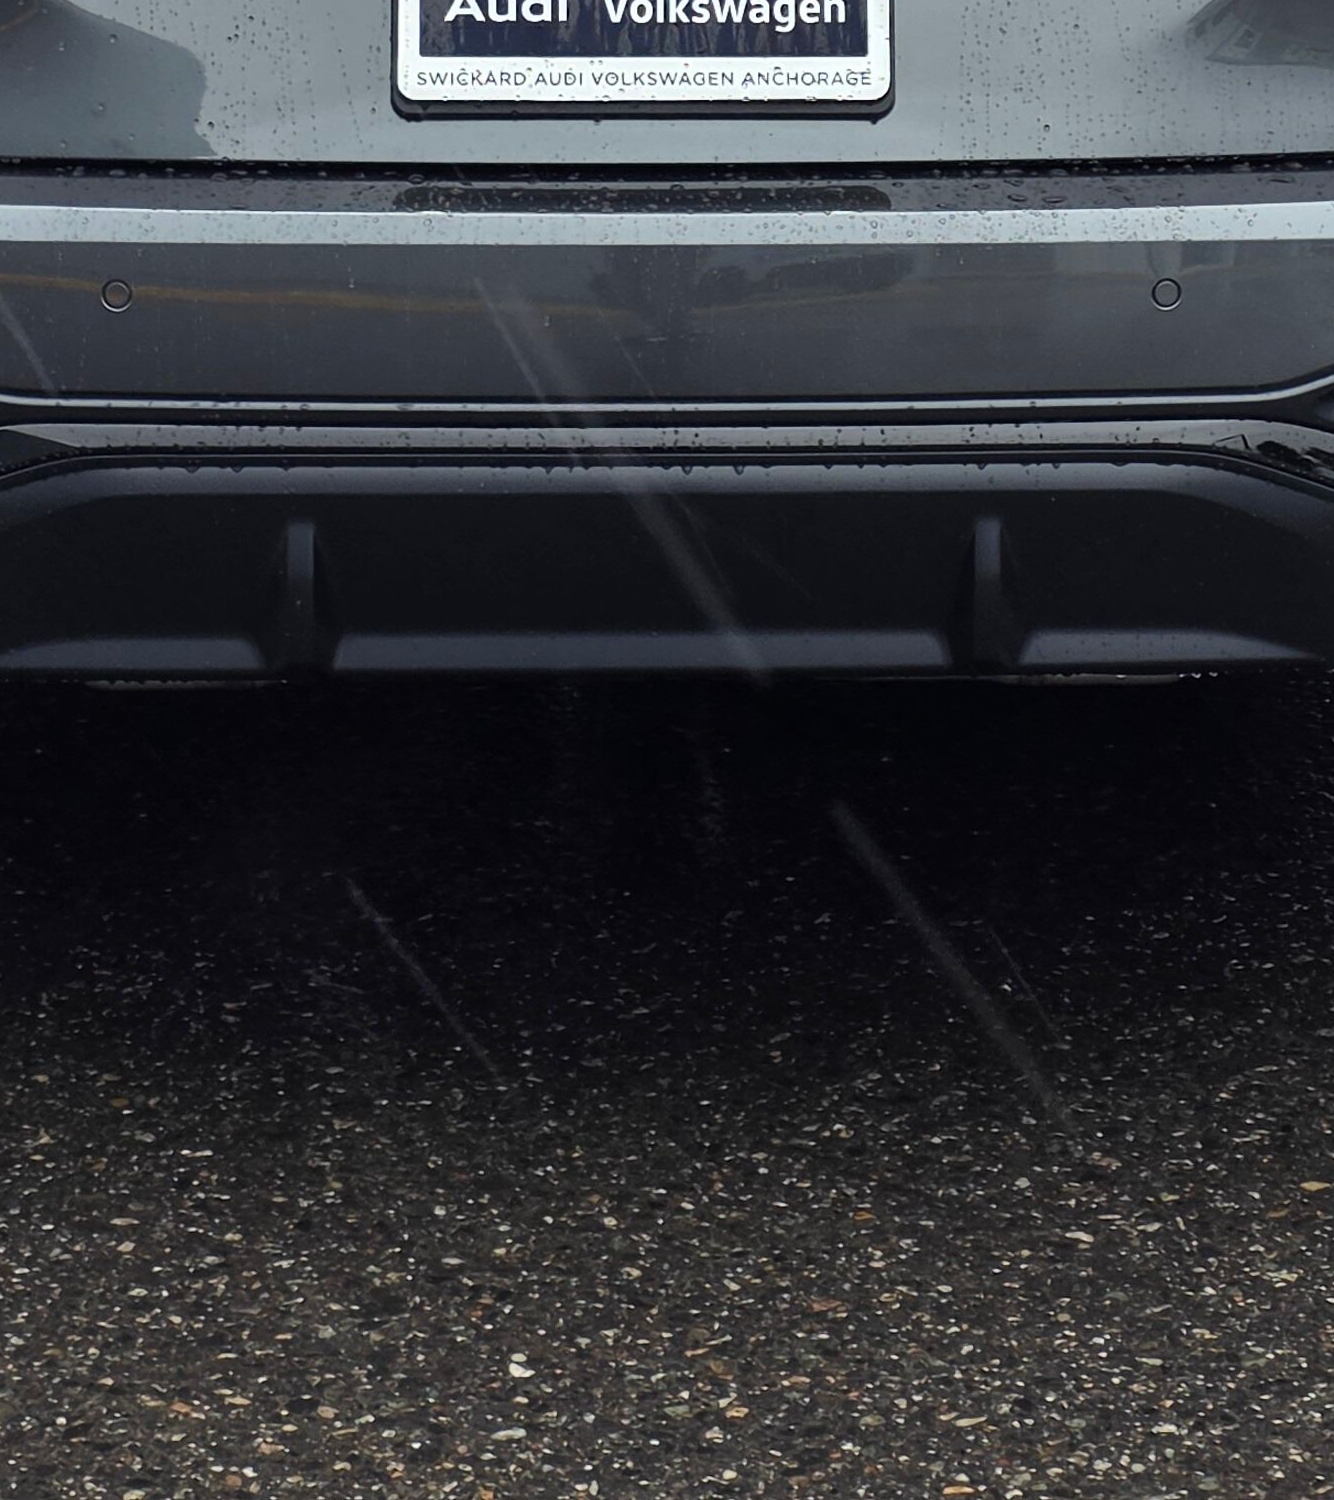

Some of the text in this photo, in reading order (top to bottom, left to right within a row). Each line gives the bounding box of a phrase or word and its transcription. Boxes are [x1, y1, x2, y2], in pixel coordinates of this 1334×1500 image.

[416, 70, 873, 87] SWICKARD AUDI VOLKSWAGEN ANCHORAGE
